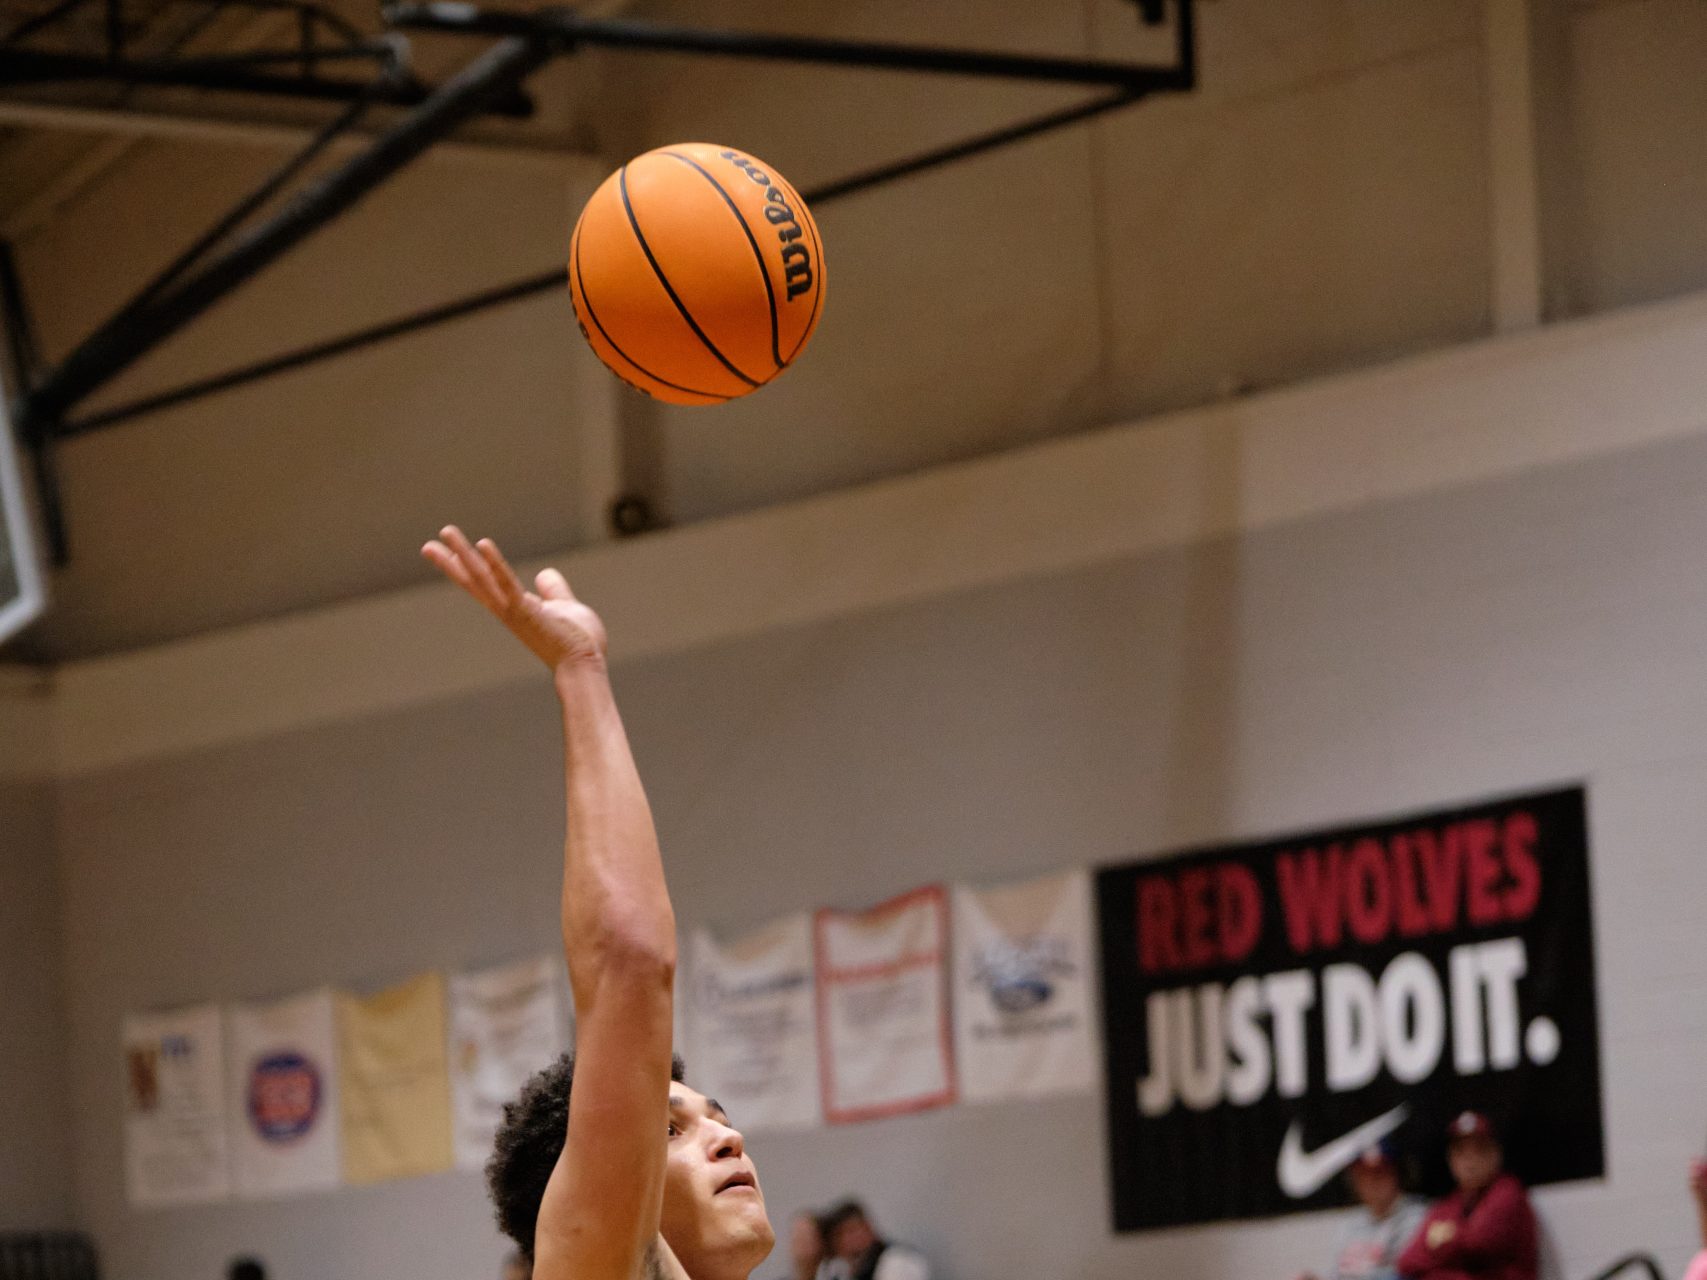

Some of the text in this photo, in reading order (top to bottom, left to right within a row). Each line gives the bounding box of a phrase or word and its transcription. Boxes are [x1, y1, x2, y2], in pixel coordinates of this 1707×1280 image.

[720, 150, 813, 302] Wilson
[1136, 811, 1541, 974] RED WOLVES
[1137, 969, 1314, 1118] JUST
[1321, 951, 1445, 1093] DO
[1449, 936, 1561, 1076] IT.
